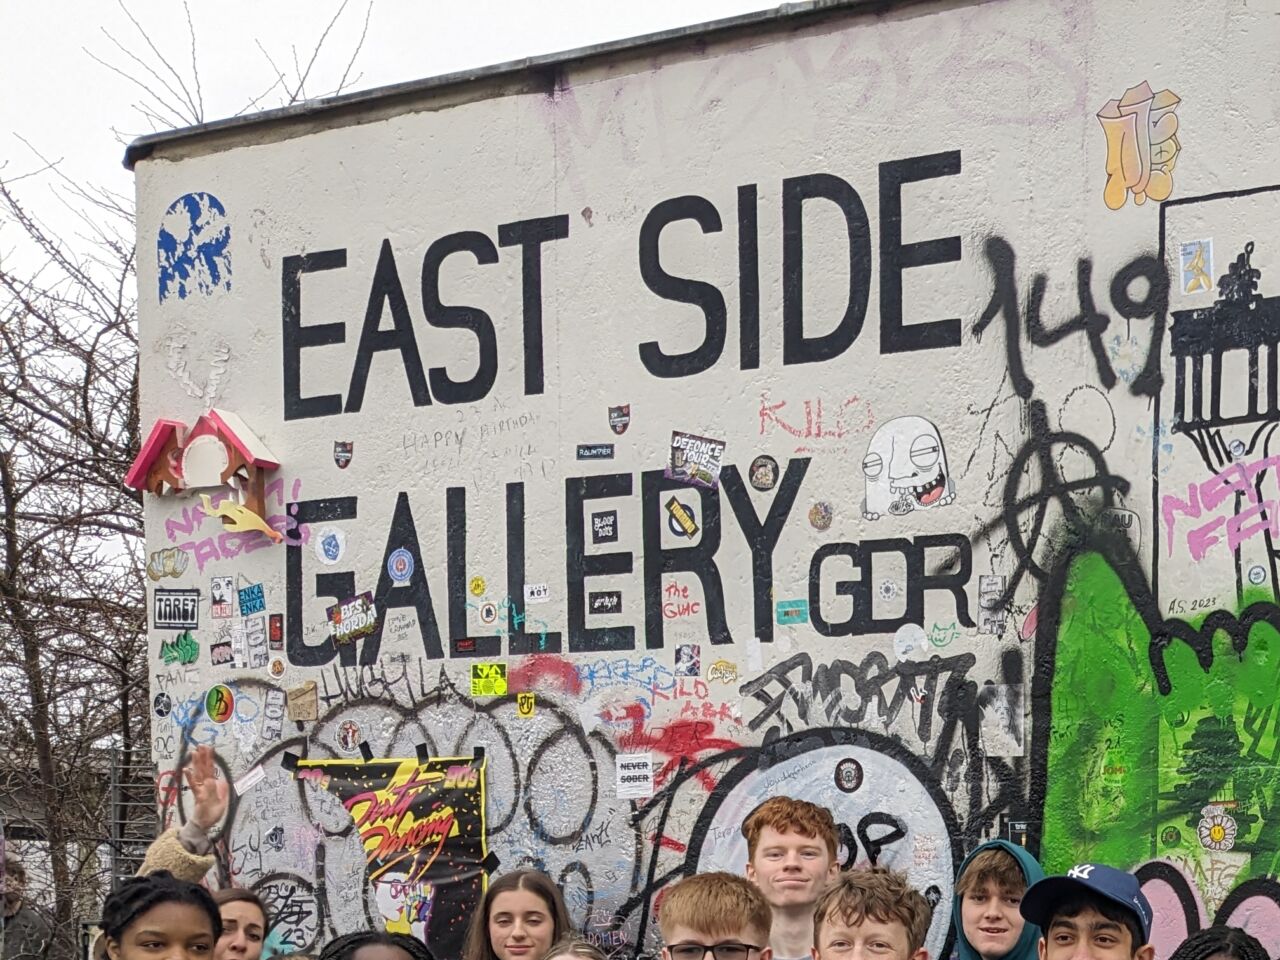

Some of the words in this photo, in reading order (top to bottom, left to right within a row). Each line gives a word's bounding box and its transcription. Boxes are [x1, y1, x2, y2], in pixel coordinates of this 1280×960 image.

[282, 214, 569, 421] EAST
[639, 150, 962, 378] SIDE
[972, 235, 1170, 399] 149
[673, 434, 724, 457] DÉFONCE
[682, 450, 709, 467] TOUR
[285, 457, 812, 667] GALLERY
[239, 584, 264, 600] ENKA
[665, 581, 689, 599] The
[241, 598, 265, 614] ENKA
[1190, 596, 1217, 612] 2023
[620, 762, 649, 771] NEVER
[620, 774, 650, 784] SOBER
